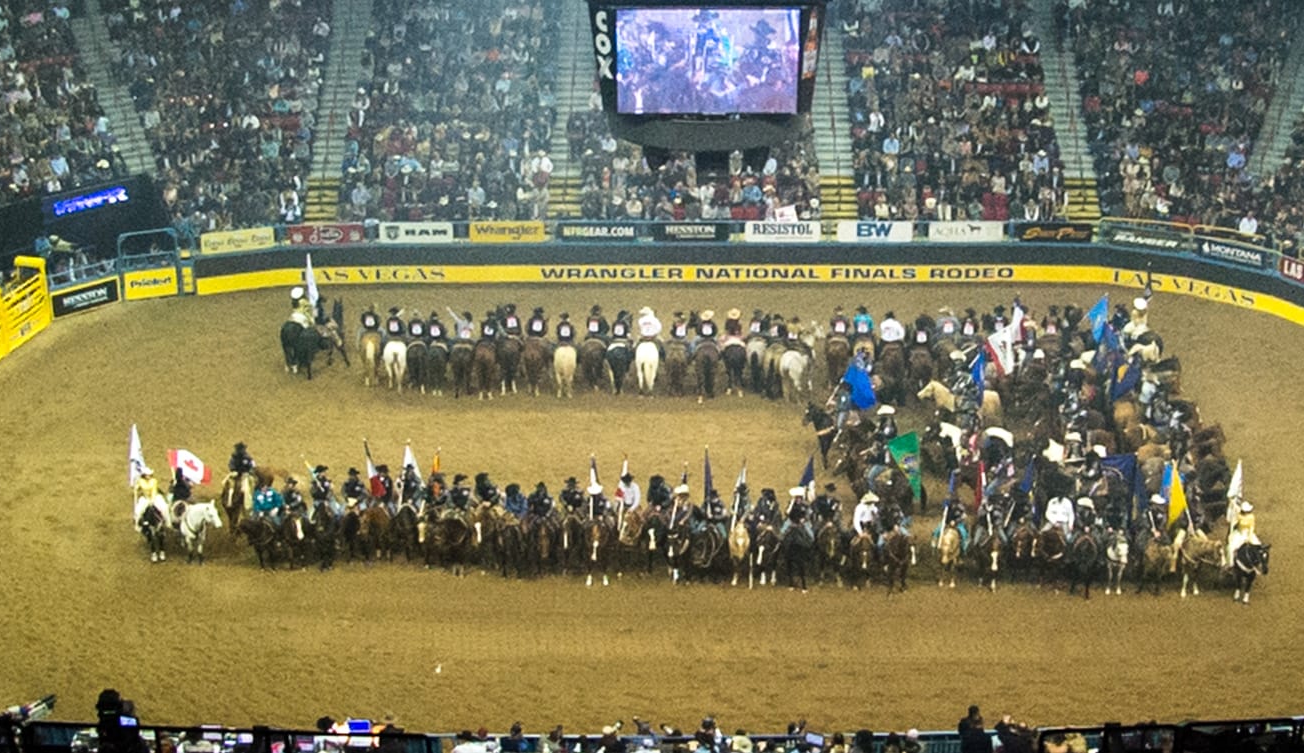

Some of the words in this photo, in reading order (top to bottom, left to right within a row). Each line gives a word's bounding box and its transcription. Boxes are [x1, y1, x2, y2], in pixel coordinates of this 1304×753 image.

[595, 10, 614, 80] COX
[405, 228, 447, 236] RAM
[474, 224, 540, 240] Wrangler
[562, 226, 635, 237] NFRGEAR.COM
[752, 223, 813, 236] RESISTOL
[1210, 243, 1263, 260] MONTANA
[358, 267, 446, 281] VEGAS
[541, 267, 684, 280] WRANGLER
[696, 267, 820, 280] NATIONAL
[830, 267, 917, 280] FINALS
[930, 267, 1015, 280] RODEO
[1283, 259, 1303, 280] LAS
[1113, 270, 1163, 288] LAS
[1172, 277, 1256, 306] VEGAS
